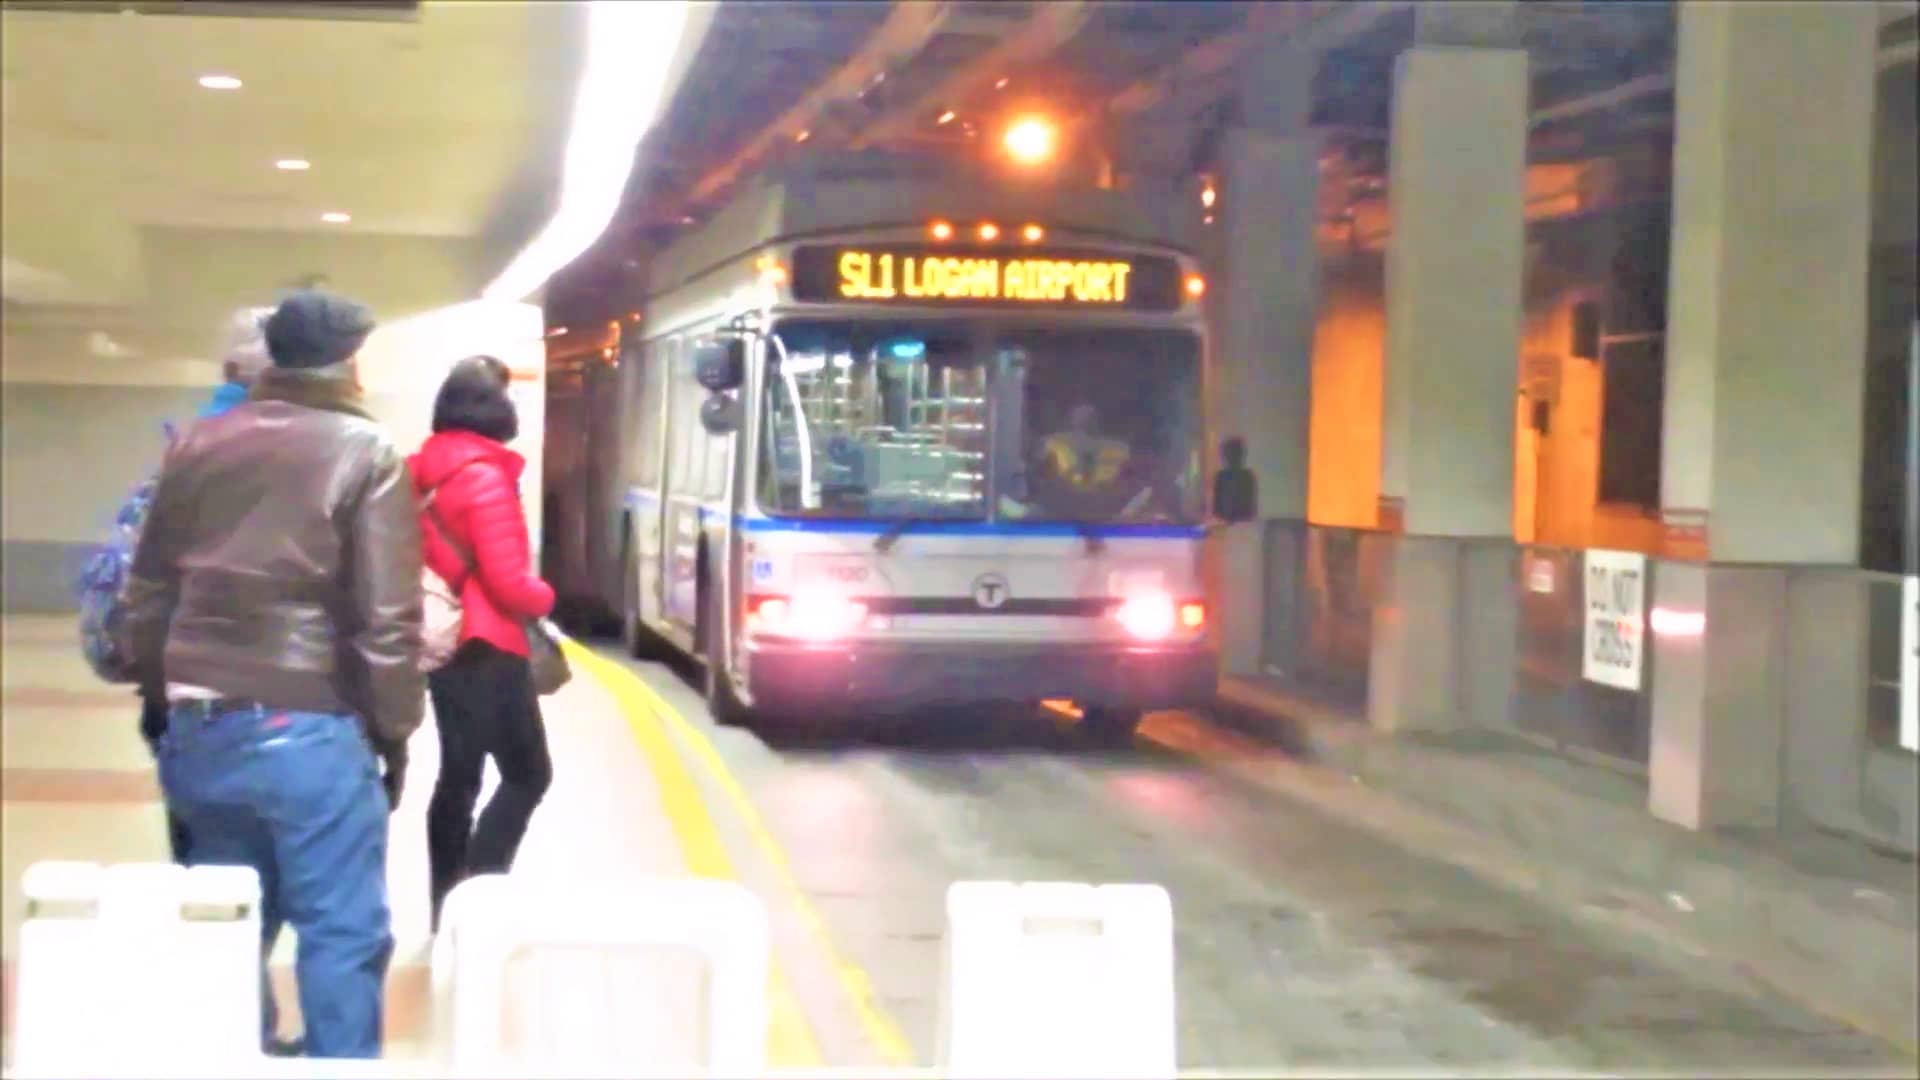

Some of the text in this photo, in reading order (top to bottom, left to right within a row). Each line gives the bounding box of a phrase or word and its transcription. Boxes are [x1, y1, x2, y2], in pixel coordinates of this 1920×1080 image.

[839, 252, 1131, 301] SL1 LOGAN AIRPORT
[1612, 568, 1638, 617] NOT
